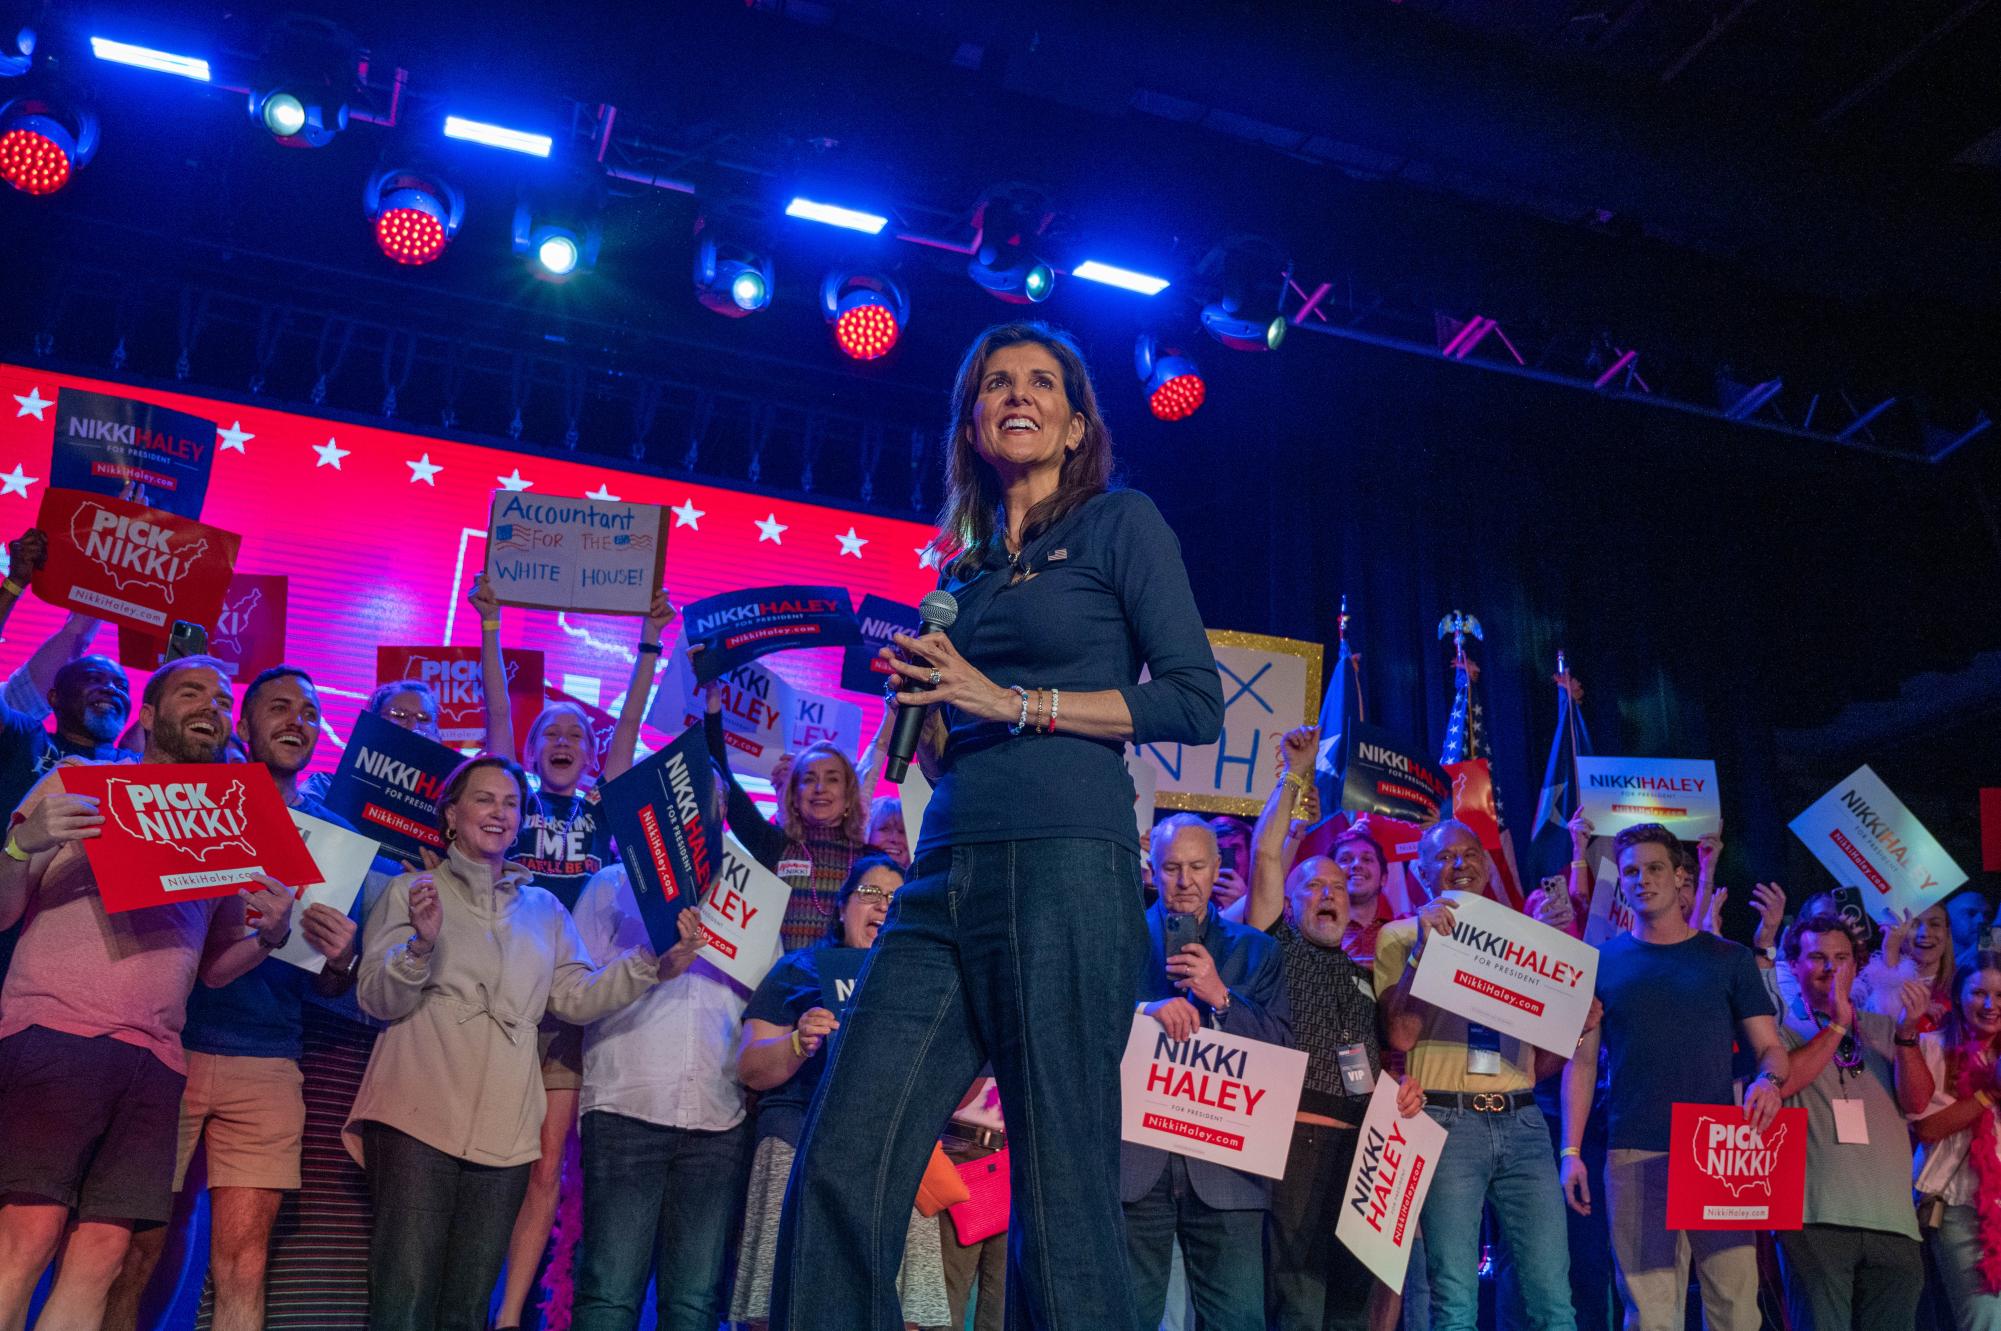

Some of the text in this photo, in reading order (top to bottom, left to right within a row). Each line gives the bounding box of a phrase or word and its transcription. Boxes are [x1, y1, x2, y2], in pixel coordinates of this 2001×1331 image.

[69, 416, 204, 462] NIKKIHALEY
[106, 444, 171, 465] FOR PRESIDENT
[97, 463, 174, 488] NikkiHaley.com
[502, 496, 635, 531] Accountant
[92, 509, 175, 554] PICK
[532, 529, 612, 550] FOR THE
[84, 531, 179, 582] NIKKI
[495, 560, 643, 587] WHITE HOUSE!
[74, 588, 163, 623] NikkiHaley.com
[735, 613, 804, 629] FOR PRESIDENT
[731, 625, 816, 646] NikkiHaley.com
[125, 782, 218, 811] PICK
[385, 787, 402, 800] FOR
[1590, 774, 1705, 793] NIKKIHALEY
[136, 808, 241, 841] NIKKI
[368, 807, 440, 843] NikkiHaley.co
[666, 805, 692, 872] FOR PRESIDENT
[536, 828, 586, 861] ME
[642, 811, 675, 896] NikkiHaley.com
[1834, 832, 1887, 891] NikkiHaley.com
[168, 871, 252, 887] NikkiHaley.co
[1474, 955, 1541, 986] FOR PRESIDENT
[1459, 973, 1540, 1013] NikkiHaley.com
[1153, 1032, 1248, 1080] NIKKI
[1146, 1063, 1266, 1116] HALEY
[1347, 1070, 1365, 1082] VIP
[1171, 1104, 1224, 1122] FOR PRESIDENT
[1148, 1116, 1239, 1147] NikkiHaley.com
[1709, 1123, 1765, 1150] PICK
[1351, 1125, 1386, 1217] NIKKI
[1365, 1121, 1407, 1233] HALEY
[1707, 1149, 1771, 1176] NIKKI
[1394, 1158, 1424, 1242] NikkiHaley.com
